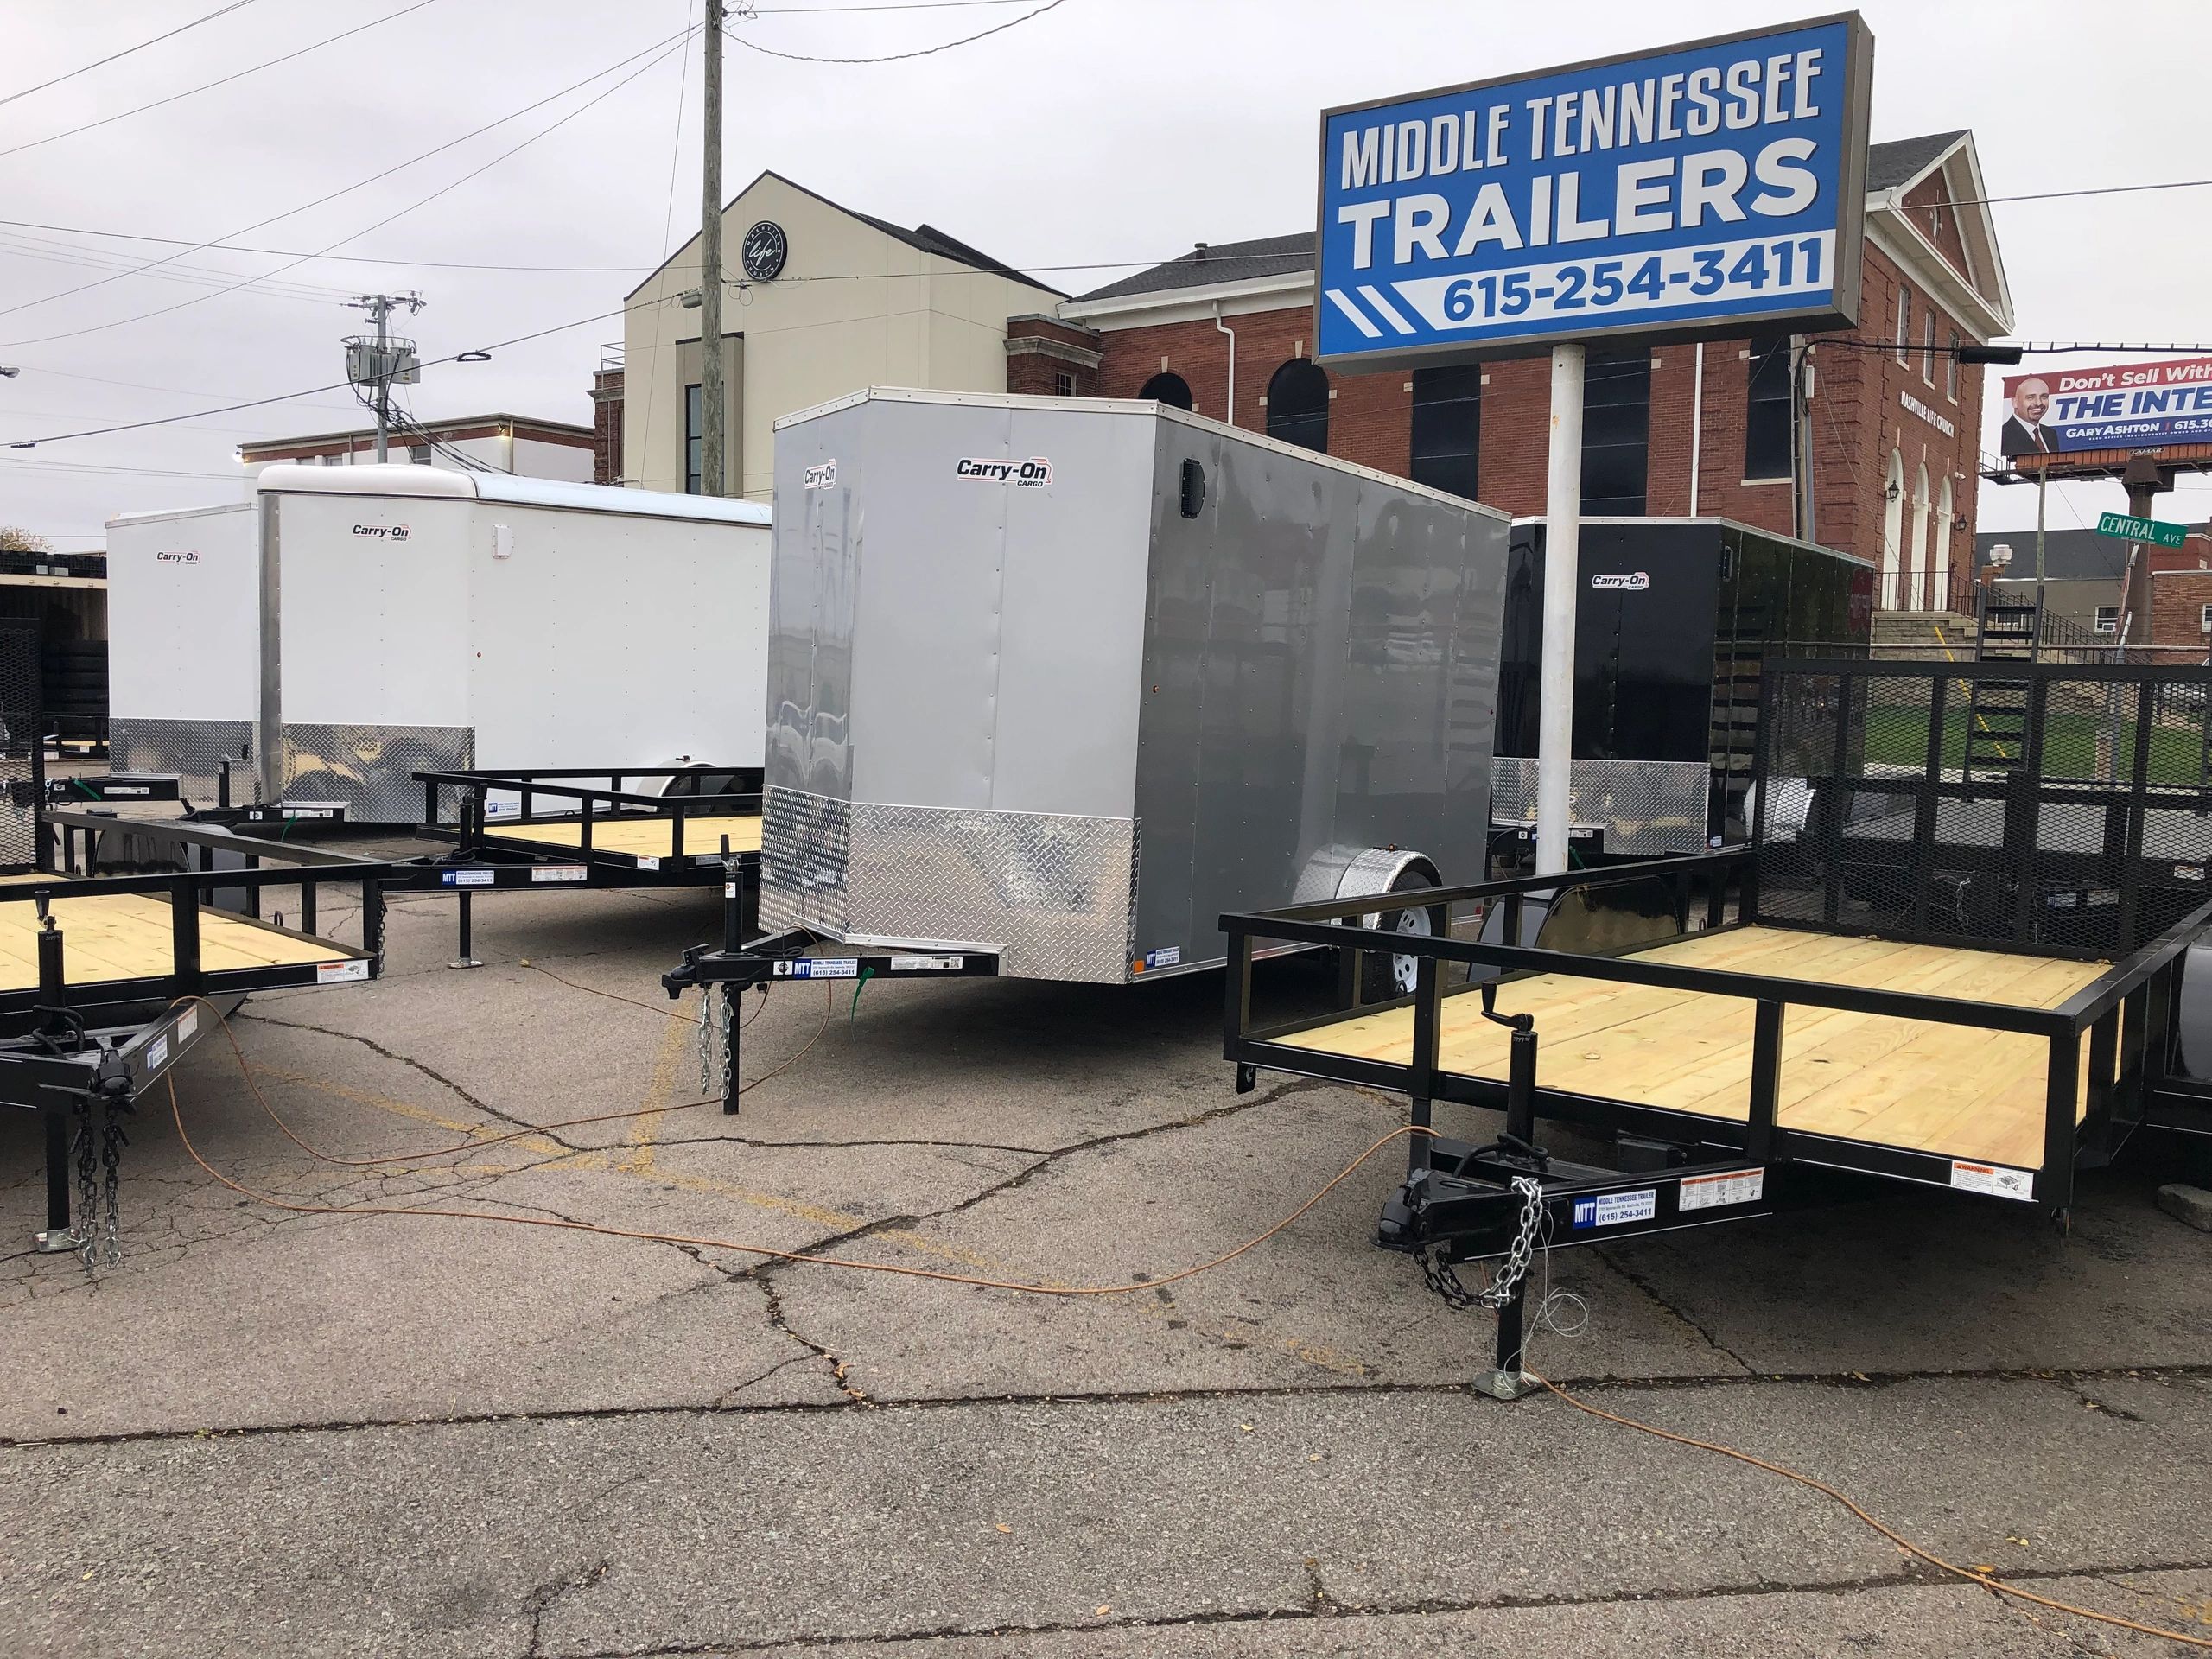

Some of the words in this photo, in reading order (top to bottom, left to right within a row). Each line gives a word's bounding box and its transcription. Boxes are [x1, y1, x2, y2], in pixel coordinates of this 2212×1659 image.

[1341, 104, 1510, 190] MIDDLE
[1526, 48, 1822, 162] TENNESSEE
[1338, 137, 1818, 270] TRAILERS
[1443, 237, 1822, 323] 615-254-3411
[2059, 373, 2116, 391] Don't
[2121, 368, 2159, 385] Sell
[1901, 390, 1927, 420] NASHVILLE
[1927, 408, 1936, 427] LIFE
[2056, 393, 2126, 421] THE
[2131, 386, 2212, 415] INTE
[2066, 427, 2103, 438] GARY
[2102, 423, 2160, 435] ASHTON
[804, 466, 835, 485] Carry-On
[957, 459, 1047, 480] Carry-On
[353, 524, 409, 537] Carry-On
[2101, 516, 2155, 540] CENTRAL
[2163, 533, 2183, 544] AVE
[157, 551, 199, 563] Carry-On
[1592, 575, 1645, 587] Carry-On
[442, 873, 455, 882] MTT
[794, 963, 810, 975] MTT
[1614, 1193, 1637, 1204] TENNESSEE
[1637, 1192, 1654, 1200] TRAILER
[1574, 1202, 1595, 1223] MTT
[1599, 1212, 1618, 1223] (615)
[1619, 1208, 1652, 1219] 254-3411
